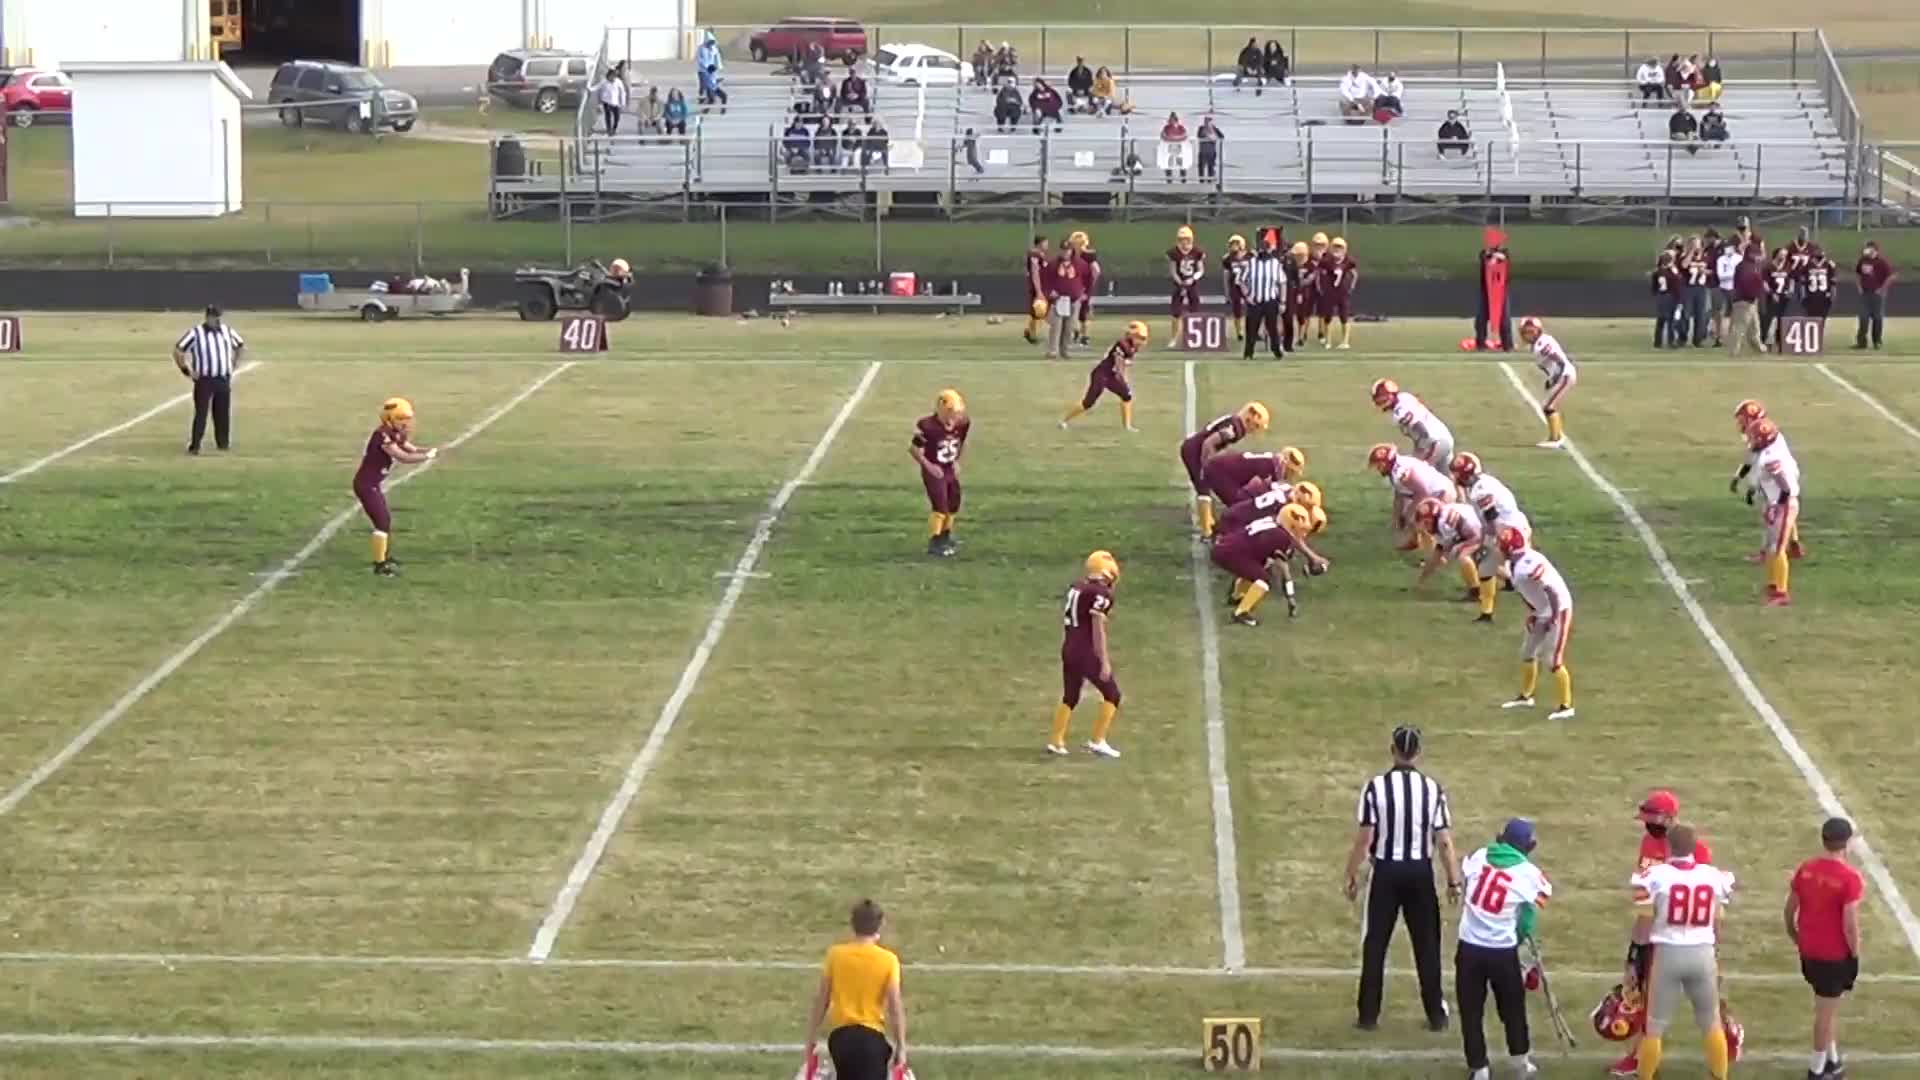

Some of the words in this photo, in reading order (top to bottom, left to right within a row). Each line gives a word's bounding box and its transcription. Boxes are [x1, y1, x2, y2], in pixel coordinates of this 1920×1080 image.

[563, 319, 597, 350] 40
[1187, 317, 1221, 349] 50
[1785, 321, 1819, 353] 40
[1471, 864, 1513, 915] 16
[1667, 884, 1714, 928] 88
[1210, 1024, 1253, 1071] 50
